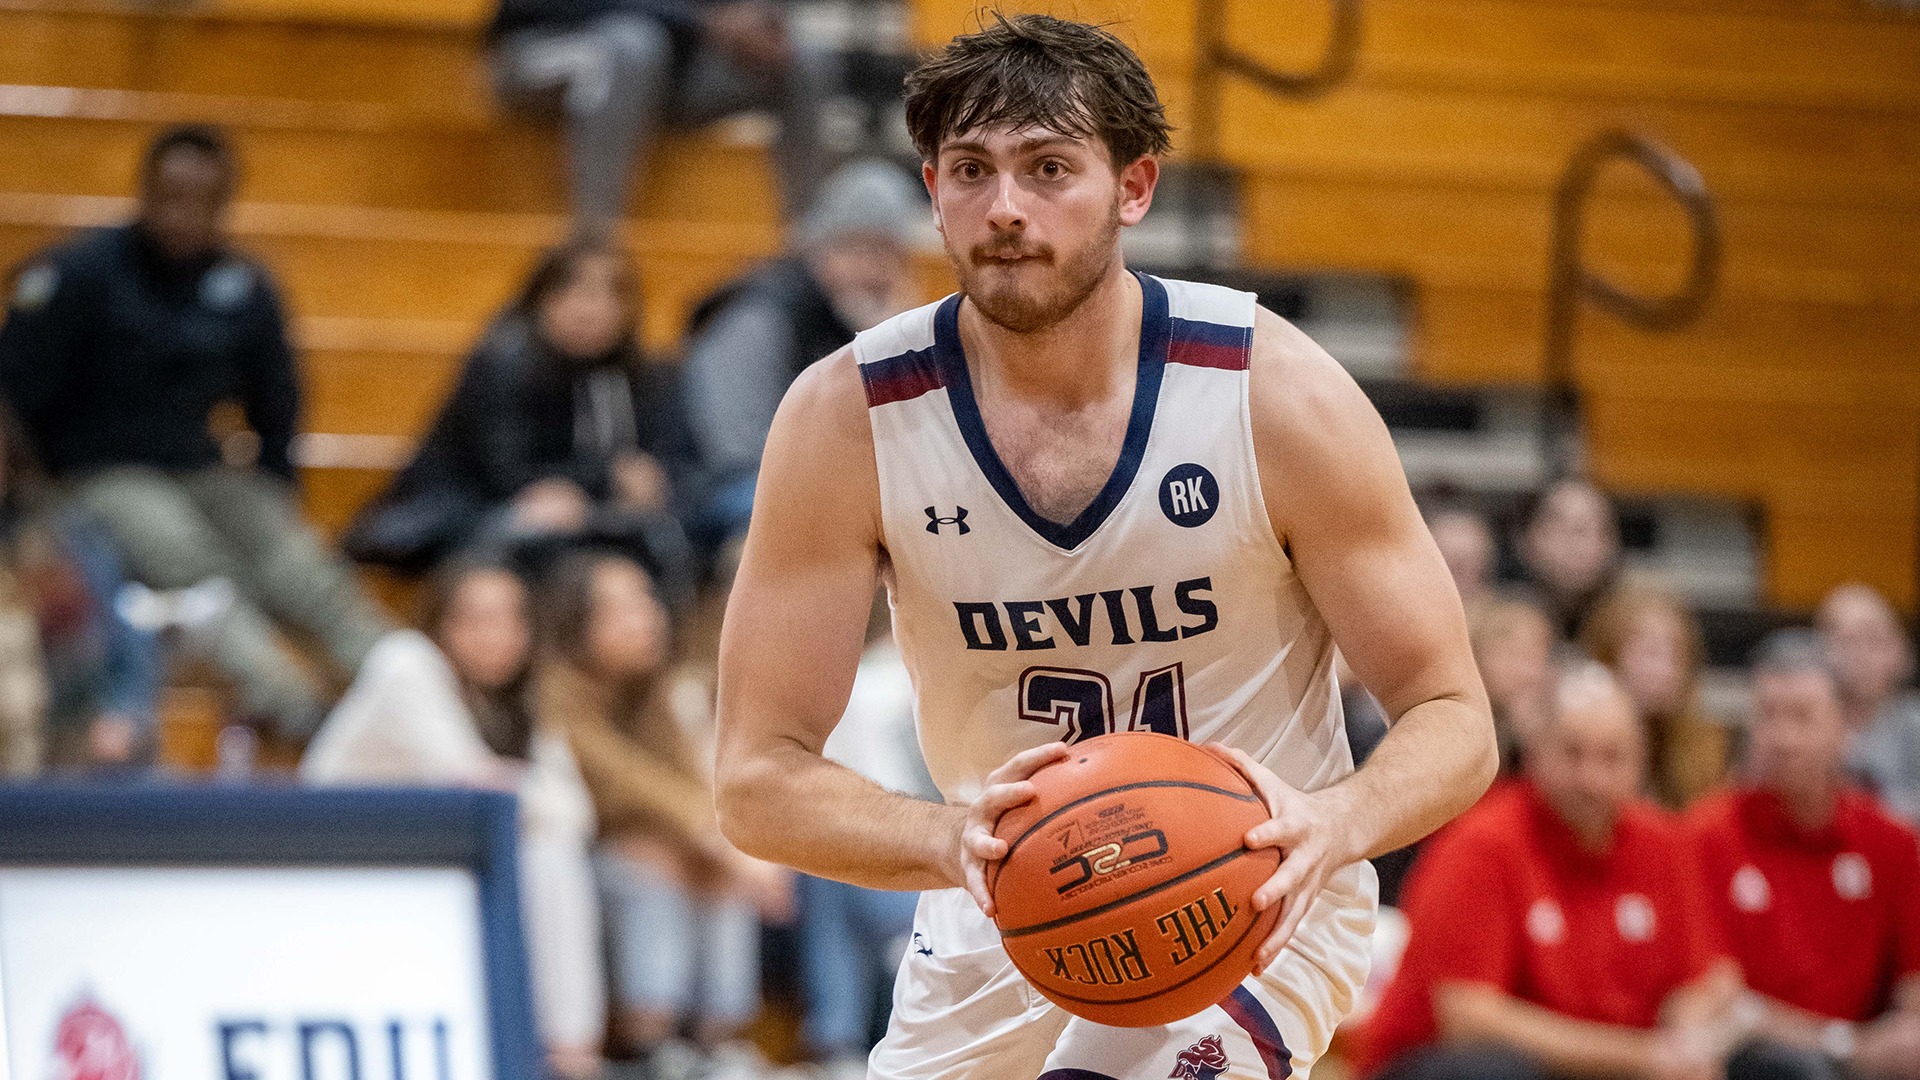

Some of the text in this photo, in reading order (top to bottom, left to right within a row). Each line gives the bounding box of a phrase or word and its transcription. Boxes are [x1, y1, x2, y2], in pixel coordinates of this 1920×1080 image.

[1169, 475, 1209, 515] RK
[952, 576, 1219, 651] DEVILS
[1049, 829, 1169, 896] C2C
[1044, 887, 1239, 986] THE ROCK
